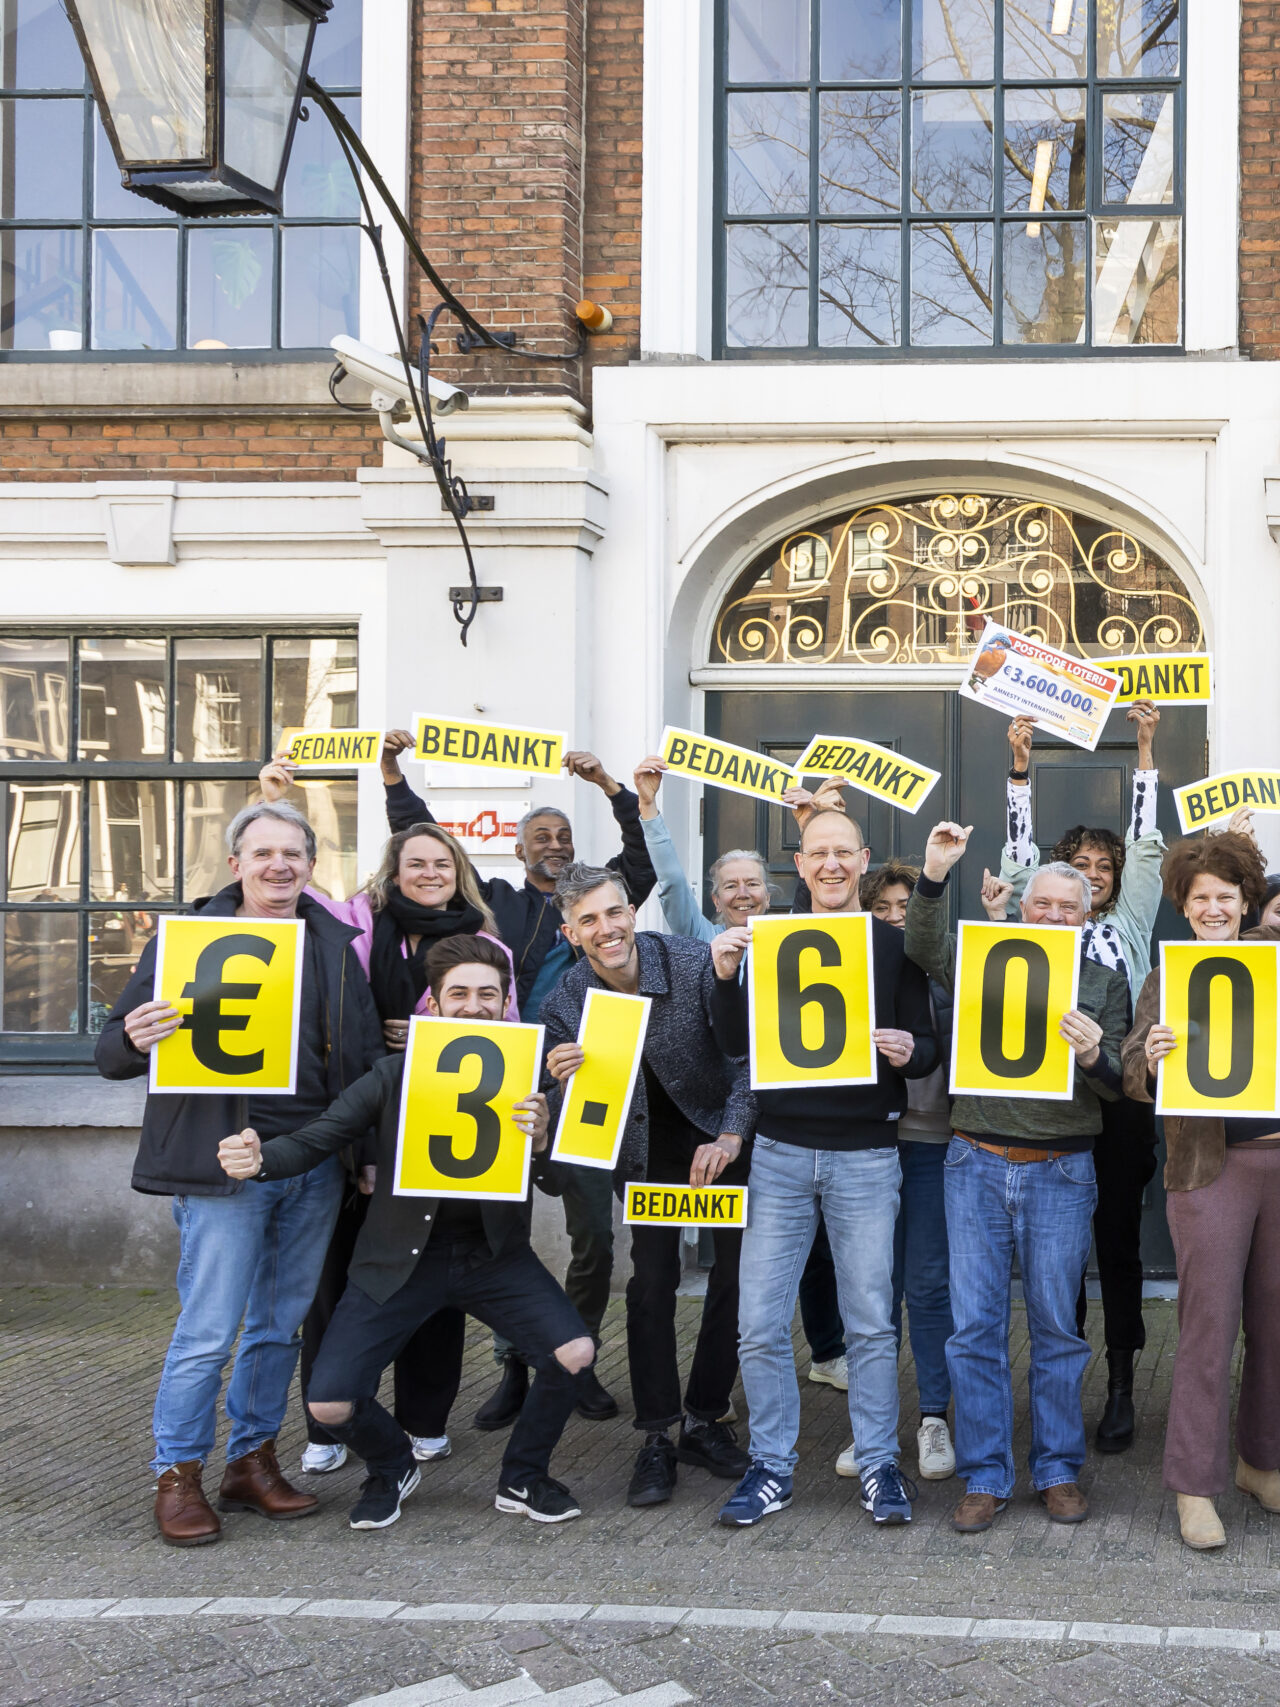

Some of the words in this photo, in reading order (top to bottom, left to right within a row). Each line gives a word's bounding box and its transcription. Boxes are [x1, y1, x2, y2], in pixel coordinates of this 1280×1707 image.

[1012, 640, 1068, 669] POSTCODE
[1067, 664, 1108, 687] LOTERIJ
[1104, 664, 1203, 696] DANKT
[993, 686, 1020, 702] AMNESTY
[1020, 698, 1066, 721] INTERNATIONAL
[288, 736, 376, 760] BEDANKT
[421, 724, 557, 768] BEDANKT
[667, 738, 793, 796] BEDANKT
[804, 744, 925, 800] BEDANKT
[178, 933, 277, 1076] €
[428, 1035, 506, 1180] 3
[776, 929, 847, 1069] 6
[979, 938, 1050, 1079] 0
[1186, 956, 1254, 1098] 0
[632, 1191, 738, 1219] BEDANKT
